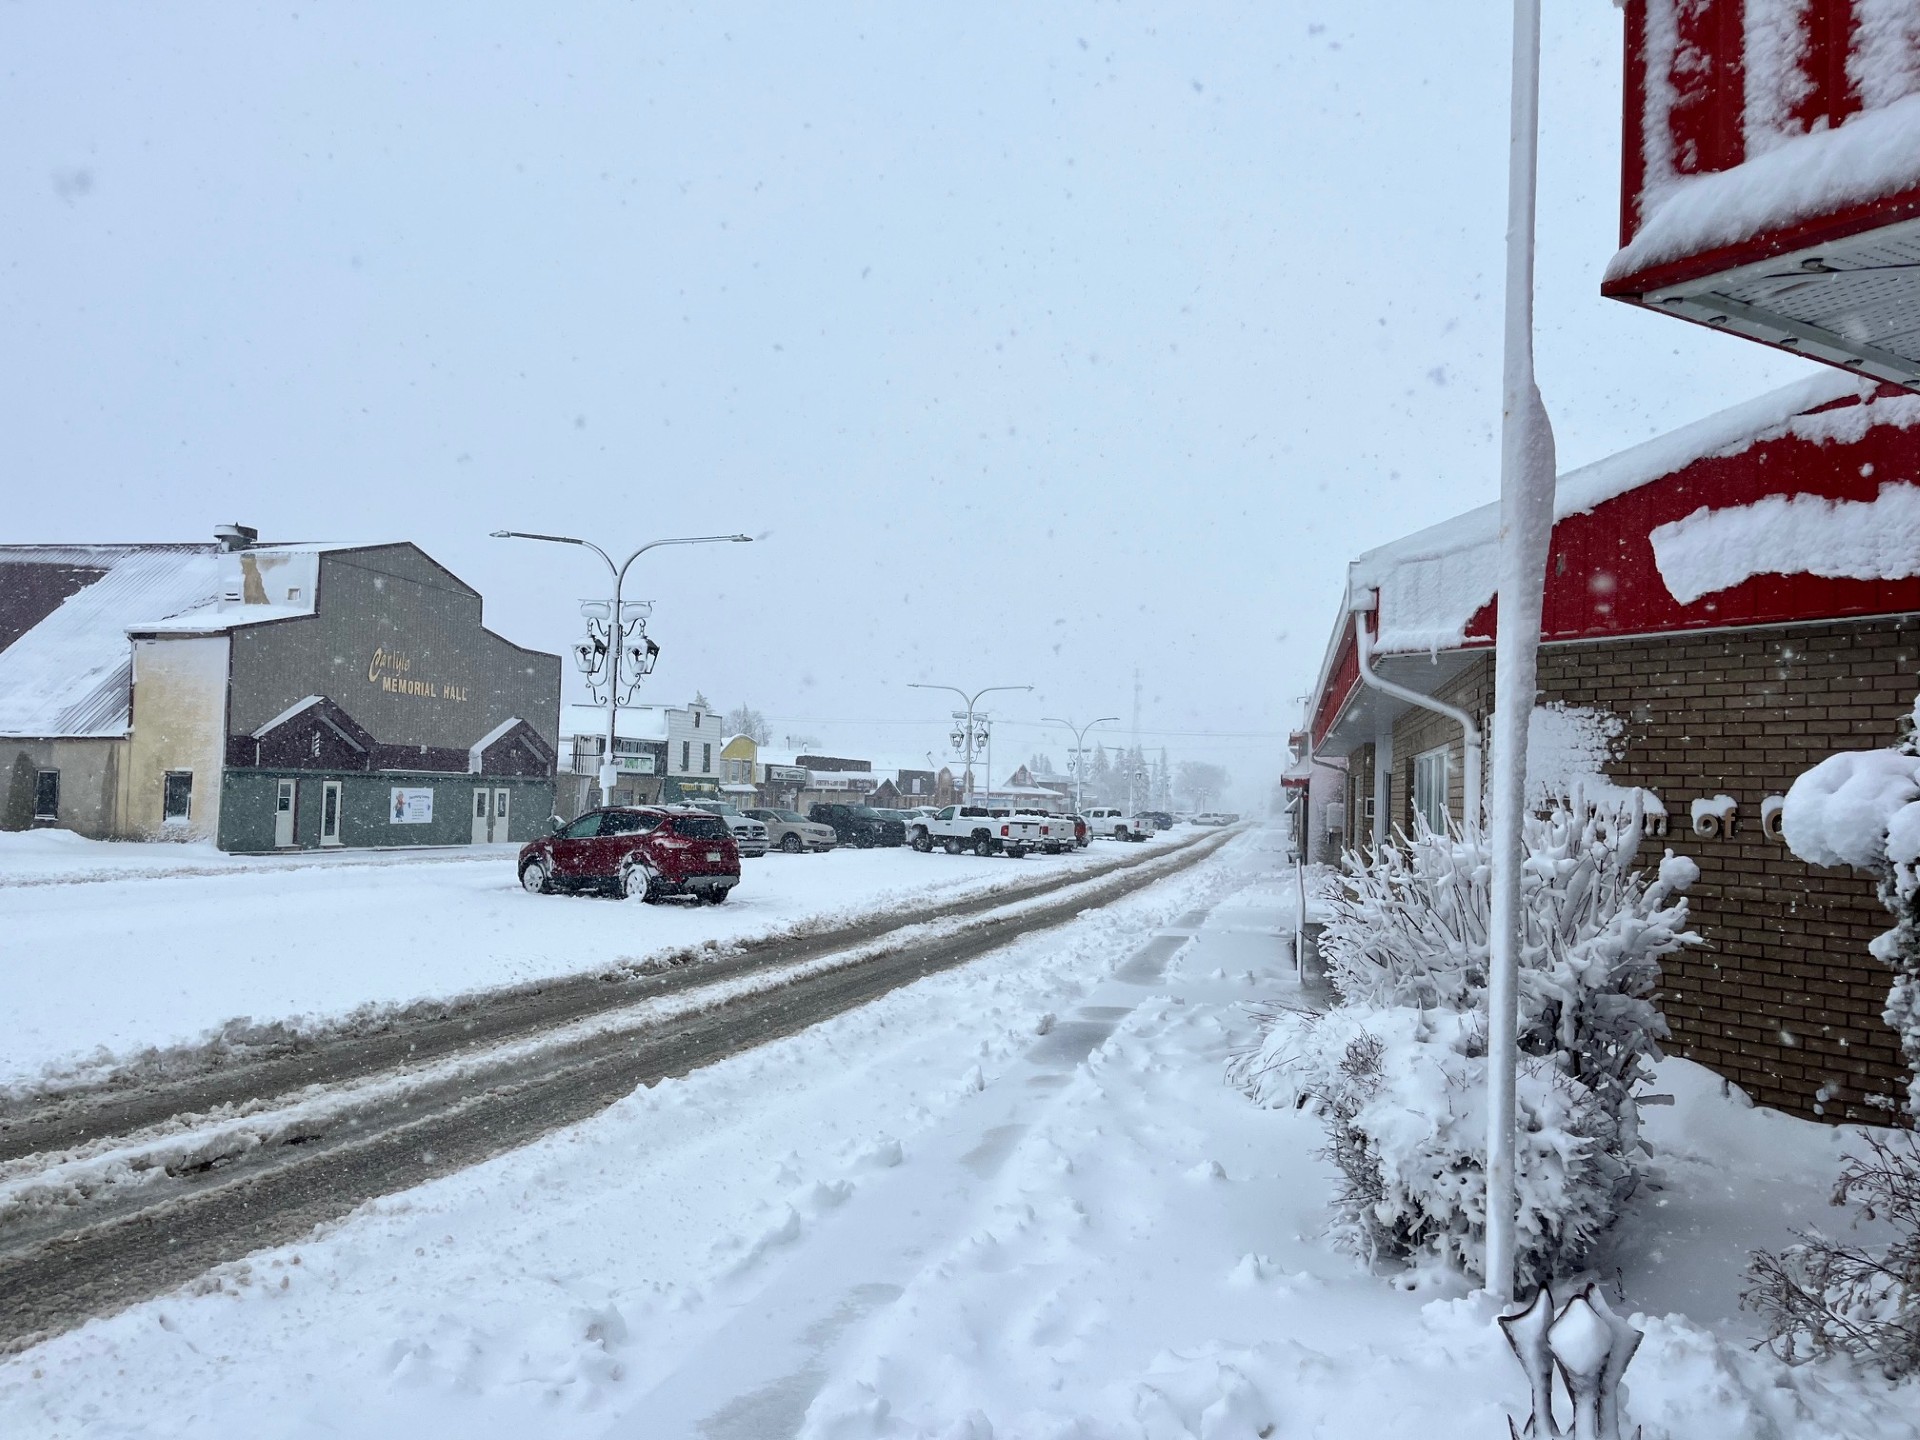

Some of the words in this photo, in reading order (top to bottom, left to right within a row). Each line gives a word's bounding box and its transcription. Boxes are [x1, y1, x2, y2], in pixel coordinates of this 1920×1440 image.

[368, 647, 411, 682] Carlyle
[382, 676, 436, 698] MEMORIAL
[443, 685, 468, 701] HALL
[1696, 806, 1736, 840] of
